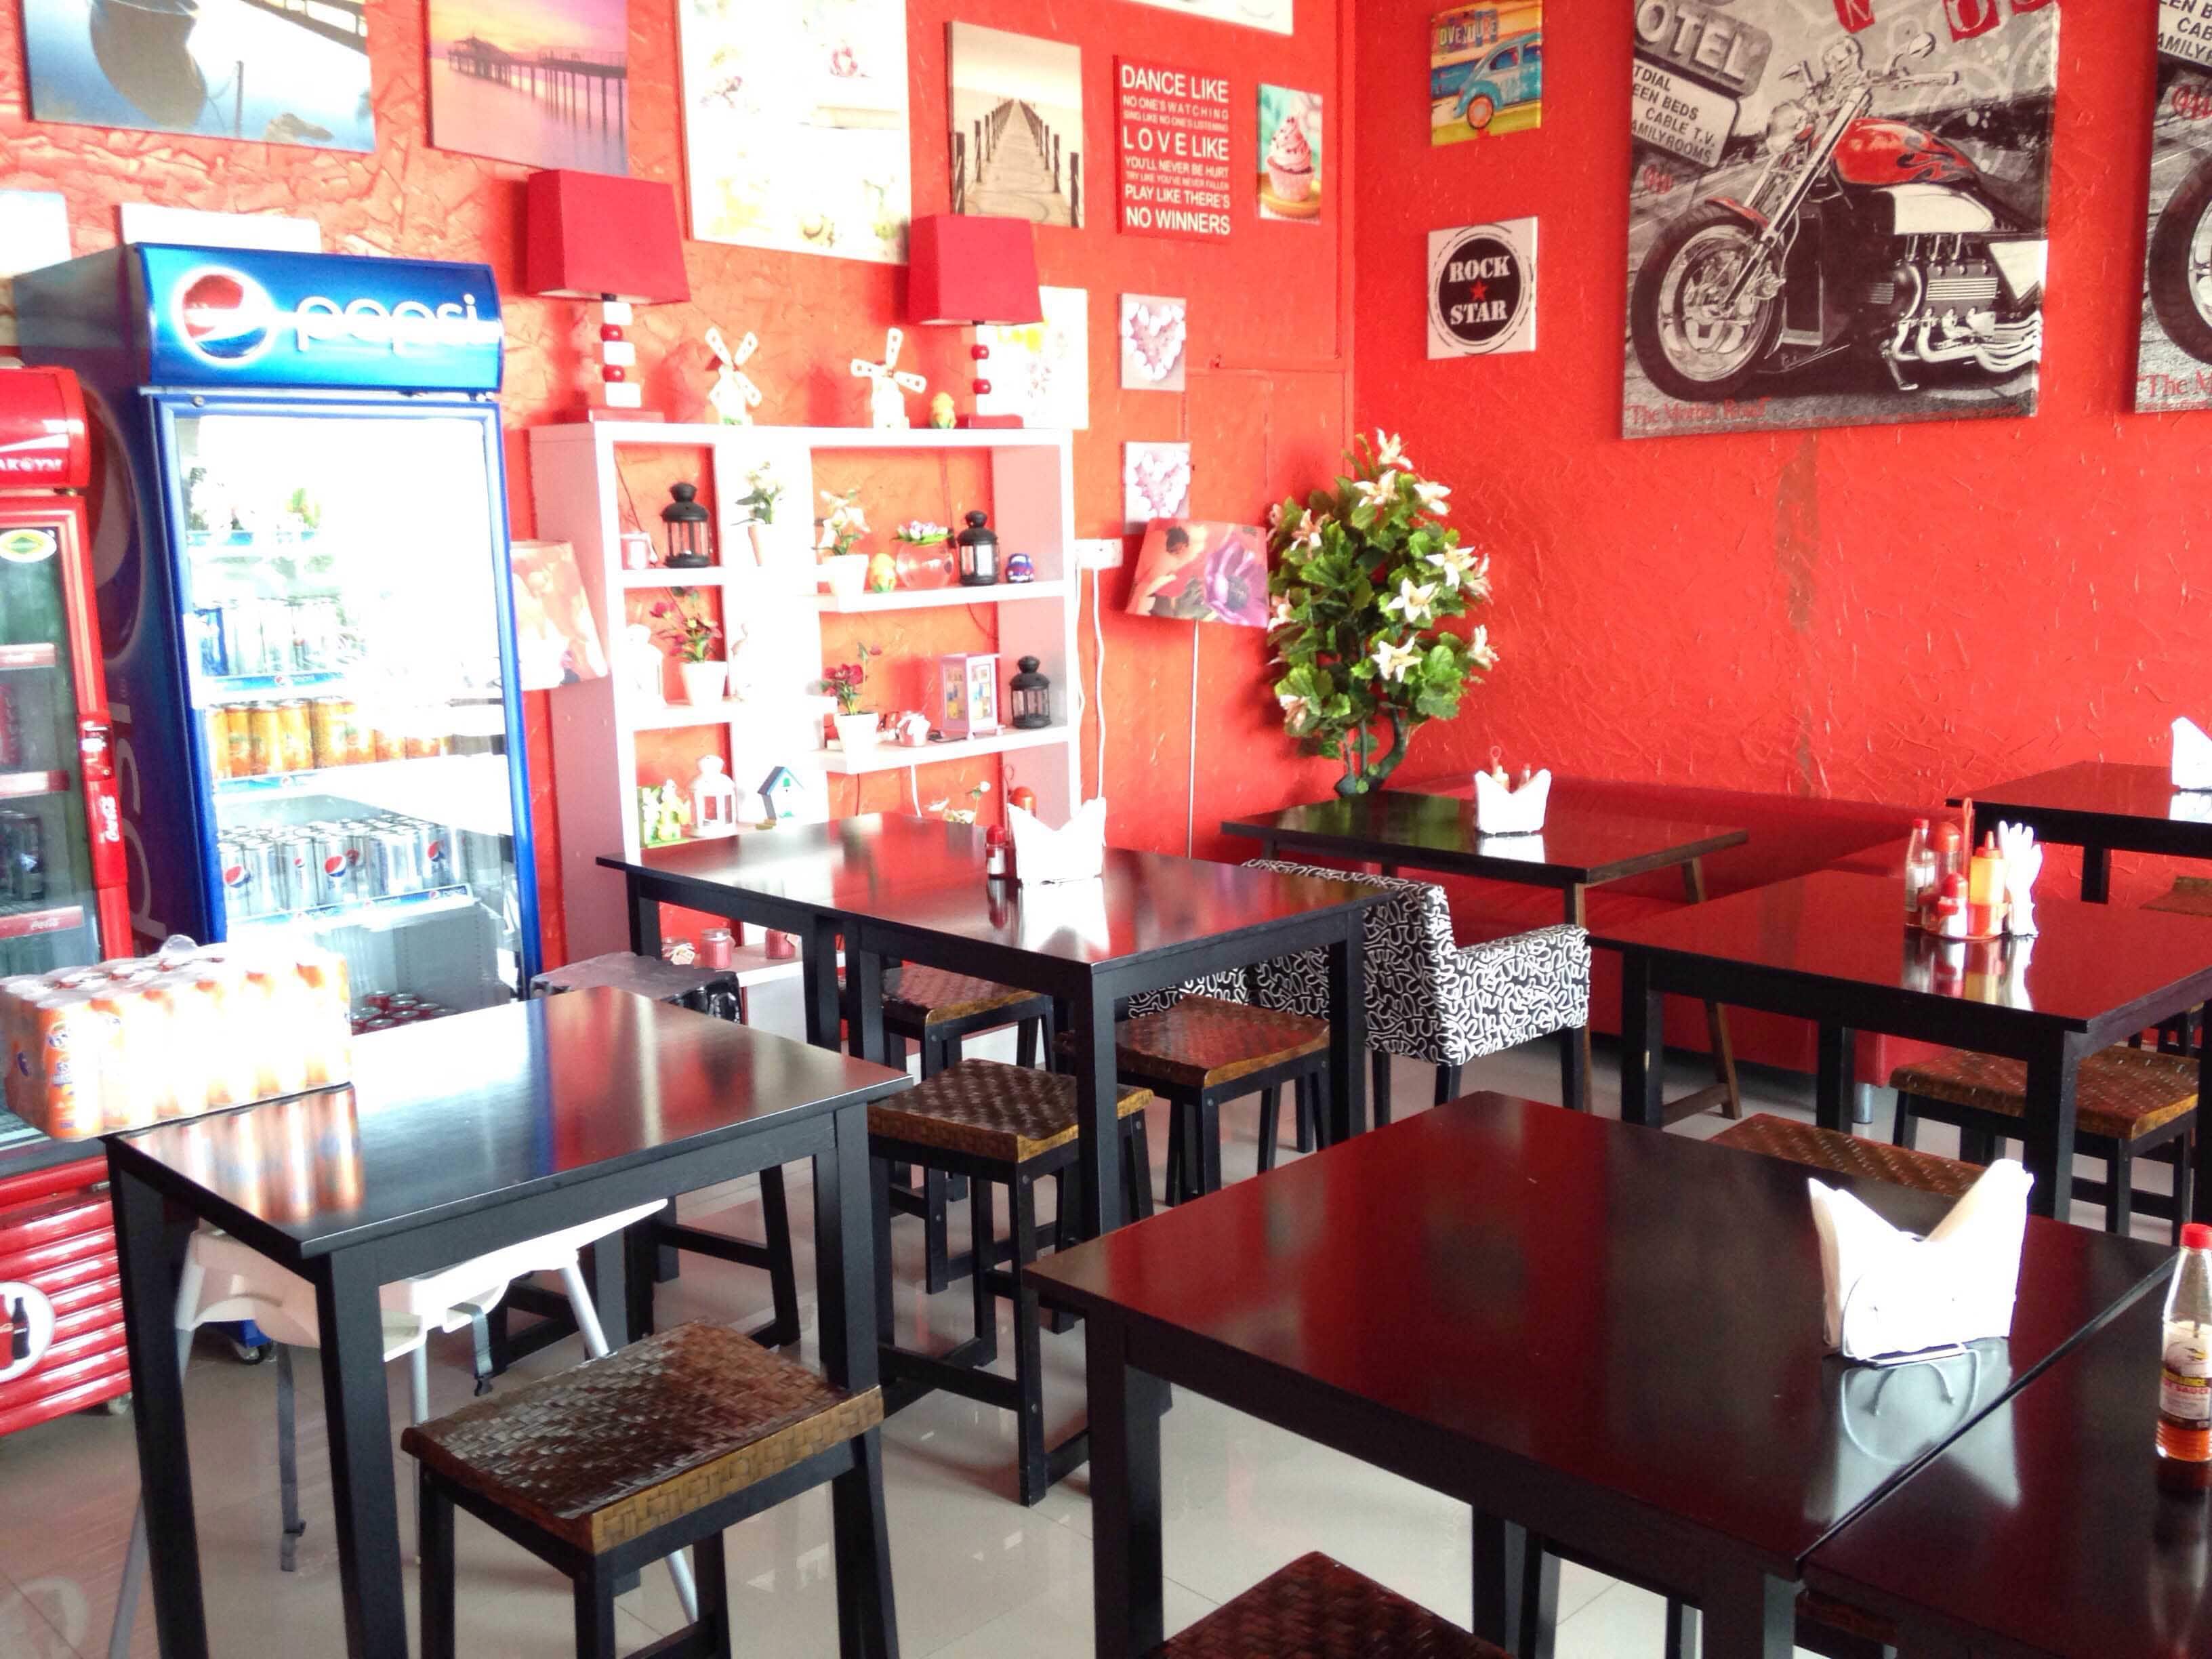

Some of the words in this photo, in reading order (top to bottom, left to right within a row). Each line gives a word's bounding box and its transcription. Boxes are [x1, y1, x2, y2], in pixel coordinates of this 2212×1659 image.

[1122, 64, 1186, 97] DANCE
[1191, 75, 1229, 103] LIKE
[1122, 94, 1137, 108] NO
[1168, 100, 1229, 121] WATCHING
[1662, 96, 1700, 121] BEDS
[1645, 107, 1689, 136] CABLE
[1694, 127, 1716, 148] T.V.
[1122, 125, 1187, 157] LOVE
[1191, 134, 1229, 161] LIKE
[1124, 155, 1157, 171] YOU'LL
[1158, 159, 1190, 174] NEVER
[1191, 163, 1204, 177] BE
[1205, 165, 1229, 179] HURT
[1124, 183, 1154, 201] PLAY
[1156, 186, 1182, 204] LIKE
[1183, 190, 1230, 209] THERE'S
[1126, 206, 1152, 228] NO
[1154, 208, 1231, 235] WINNERS
[1449, 255, 1511, 283] ROCK
[295, 293, 478, 355] pepsi
[1450, 300, 1508, 325] STAR
